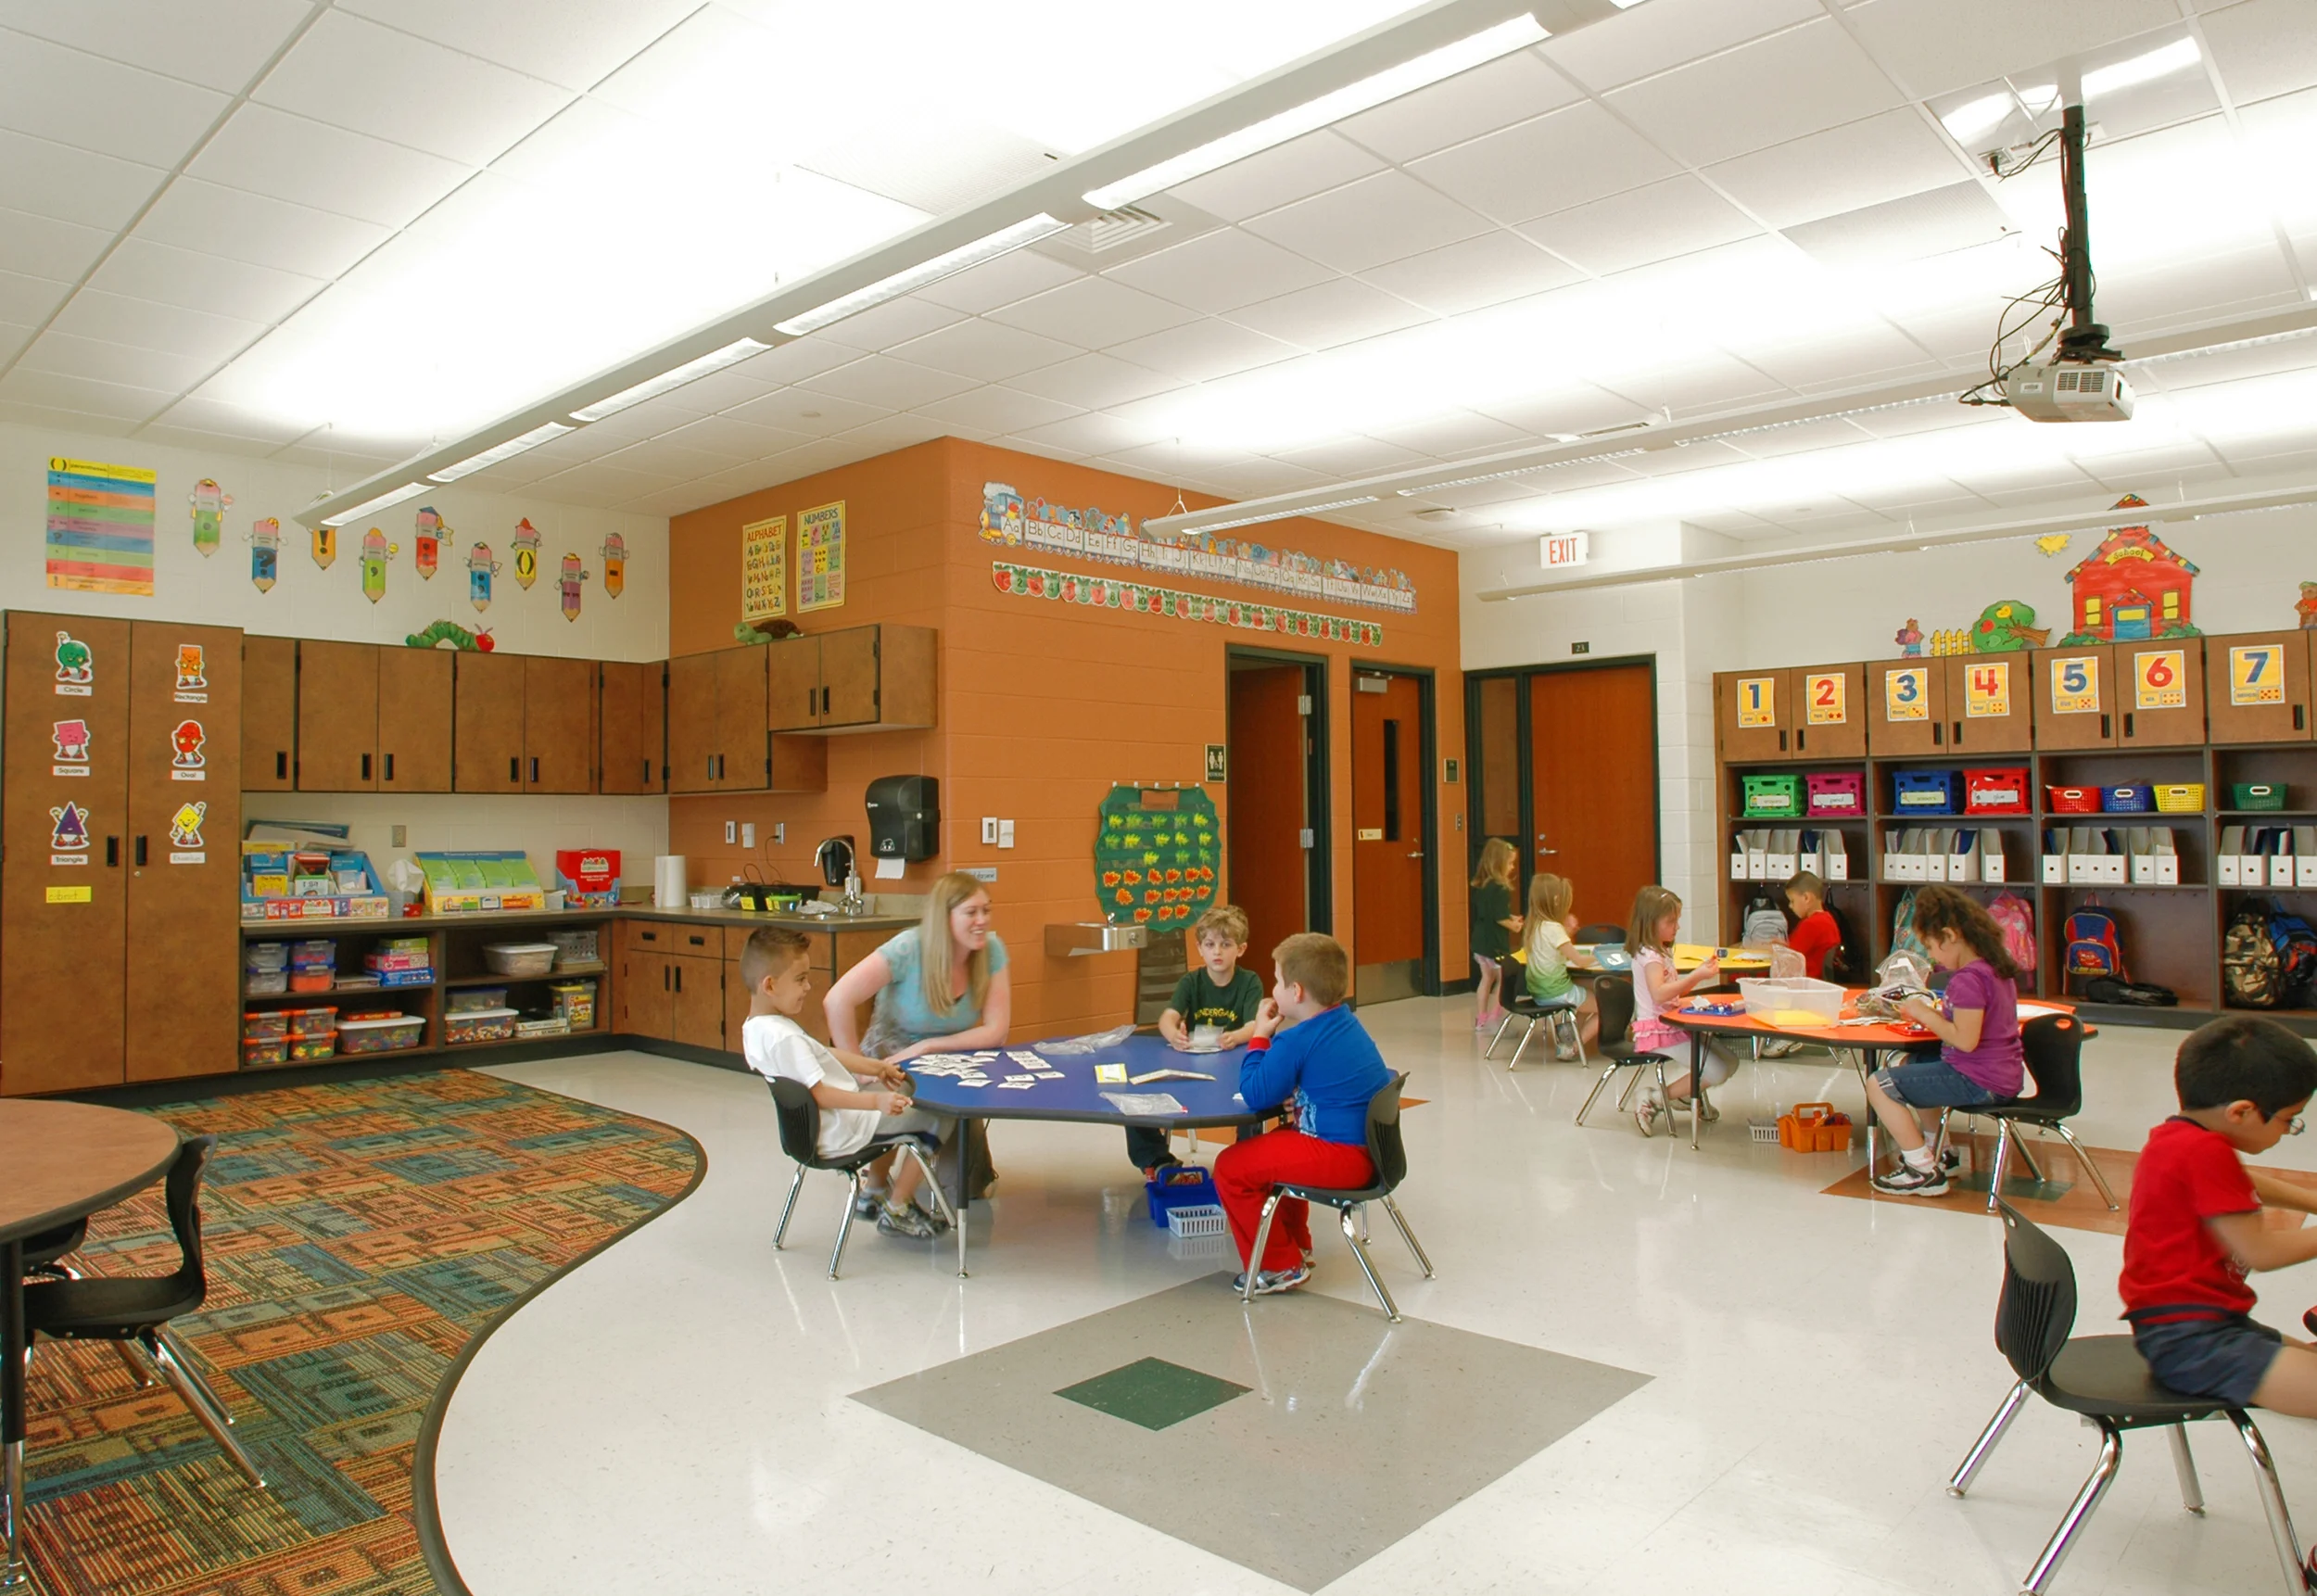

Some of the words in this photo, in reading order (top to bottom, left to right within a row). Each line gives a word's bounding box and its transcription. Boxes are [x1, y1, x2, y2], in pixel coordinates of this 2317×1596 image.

[804, 508, 839, 526] NUMBERS
[747, 524, 782, 543] ALPHABET
[1003, 518, 1019, 533] Aa
[1029, 520, 1043, 537] Bb
[1047, 525, 1062, 539] Cc
[1067, 528, 1081, 543] Dd
[1088, 533, 1100, 548] Ee
[1107, 535, 1117, 550] Ff
[1122, 538, 1137, 558] Gg
[1142, 543, 1155, 558] Hh
[1550, 538, 1577, 564] EXIT
[2112, 548, 2145, 560] School
[1017, 577, 1023, 588] 2
[1048, 583, 1054, 593] 4
[1138, 596, 1146, 605] 10
[2062, 663, 2087, 692] 5
[2146, 657, 2173, 688] 6
[2244, 652, 2269, 683] 7
[1748, 683, 1760, 709] 1
[1816, 678, 1835, 706] 2
[1896, 674, 1918, 703] 3
[1974, 668, 1998, 697] 4
[174, 693, 208, 702] Rectangle
[58, 766, 85, 775] Square
[56, 855, 84, 864] Triangle
